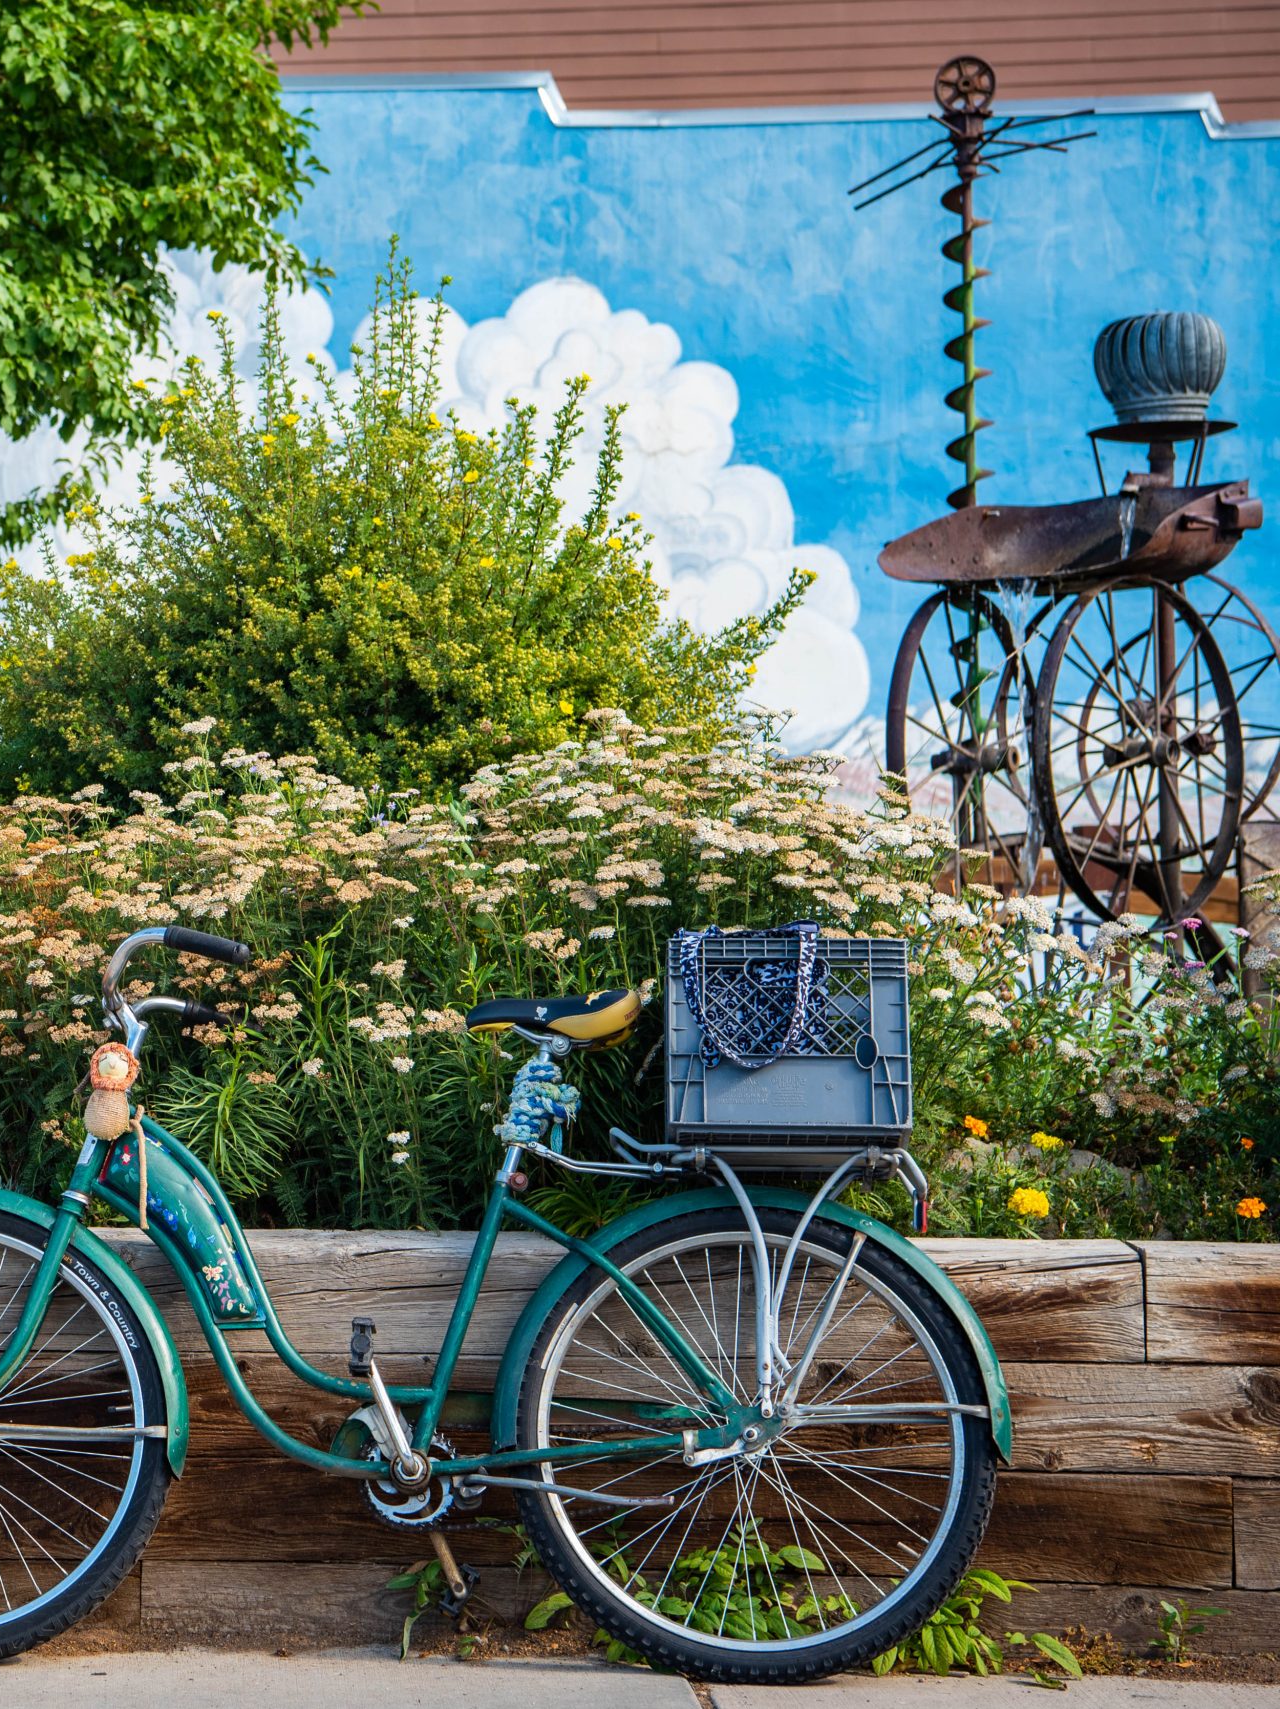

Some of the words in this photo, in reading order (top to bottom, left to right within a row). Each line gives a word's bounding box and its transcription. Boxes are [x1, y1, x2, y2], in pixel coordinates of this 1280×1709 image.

[73, 1260, 101, 1290] Town
[99, 1290, 110, 1300] &
[108, 1301, 138, 1349] Country
